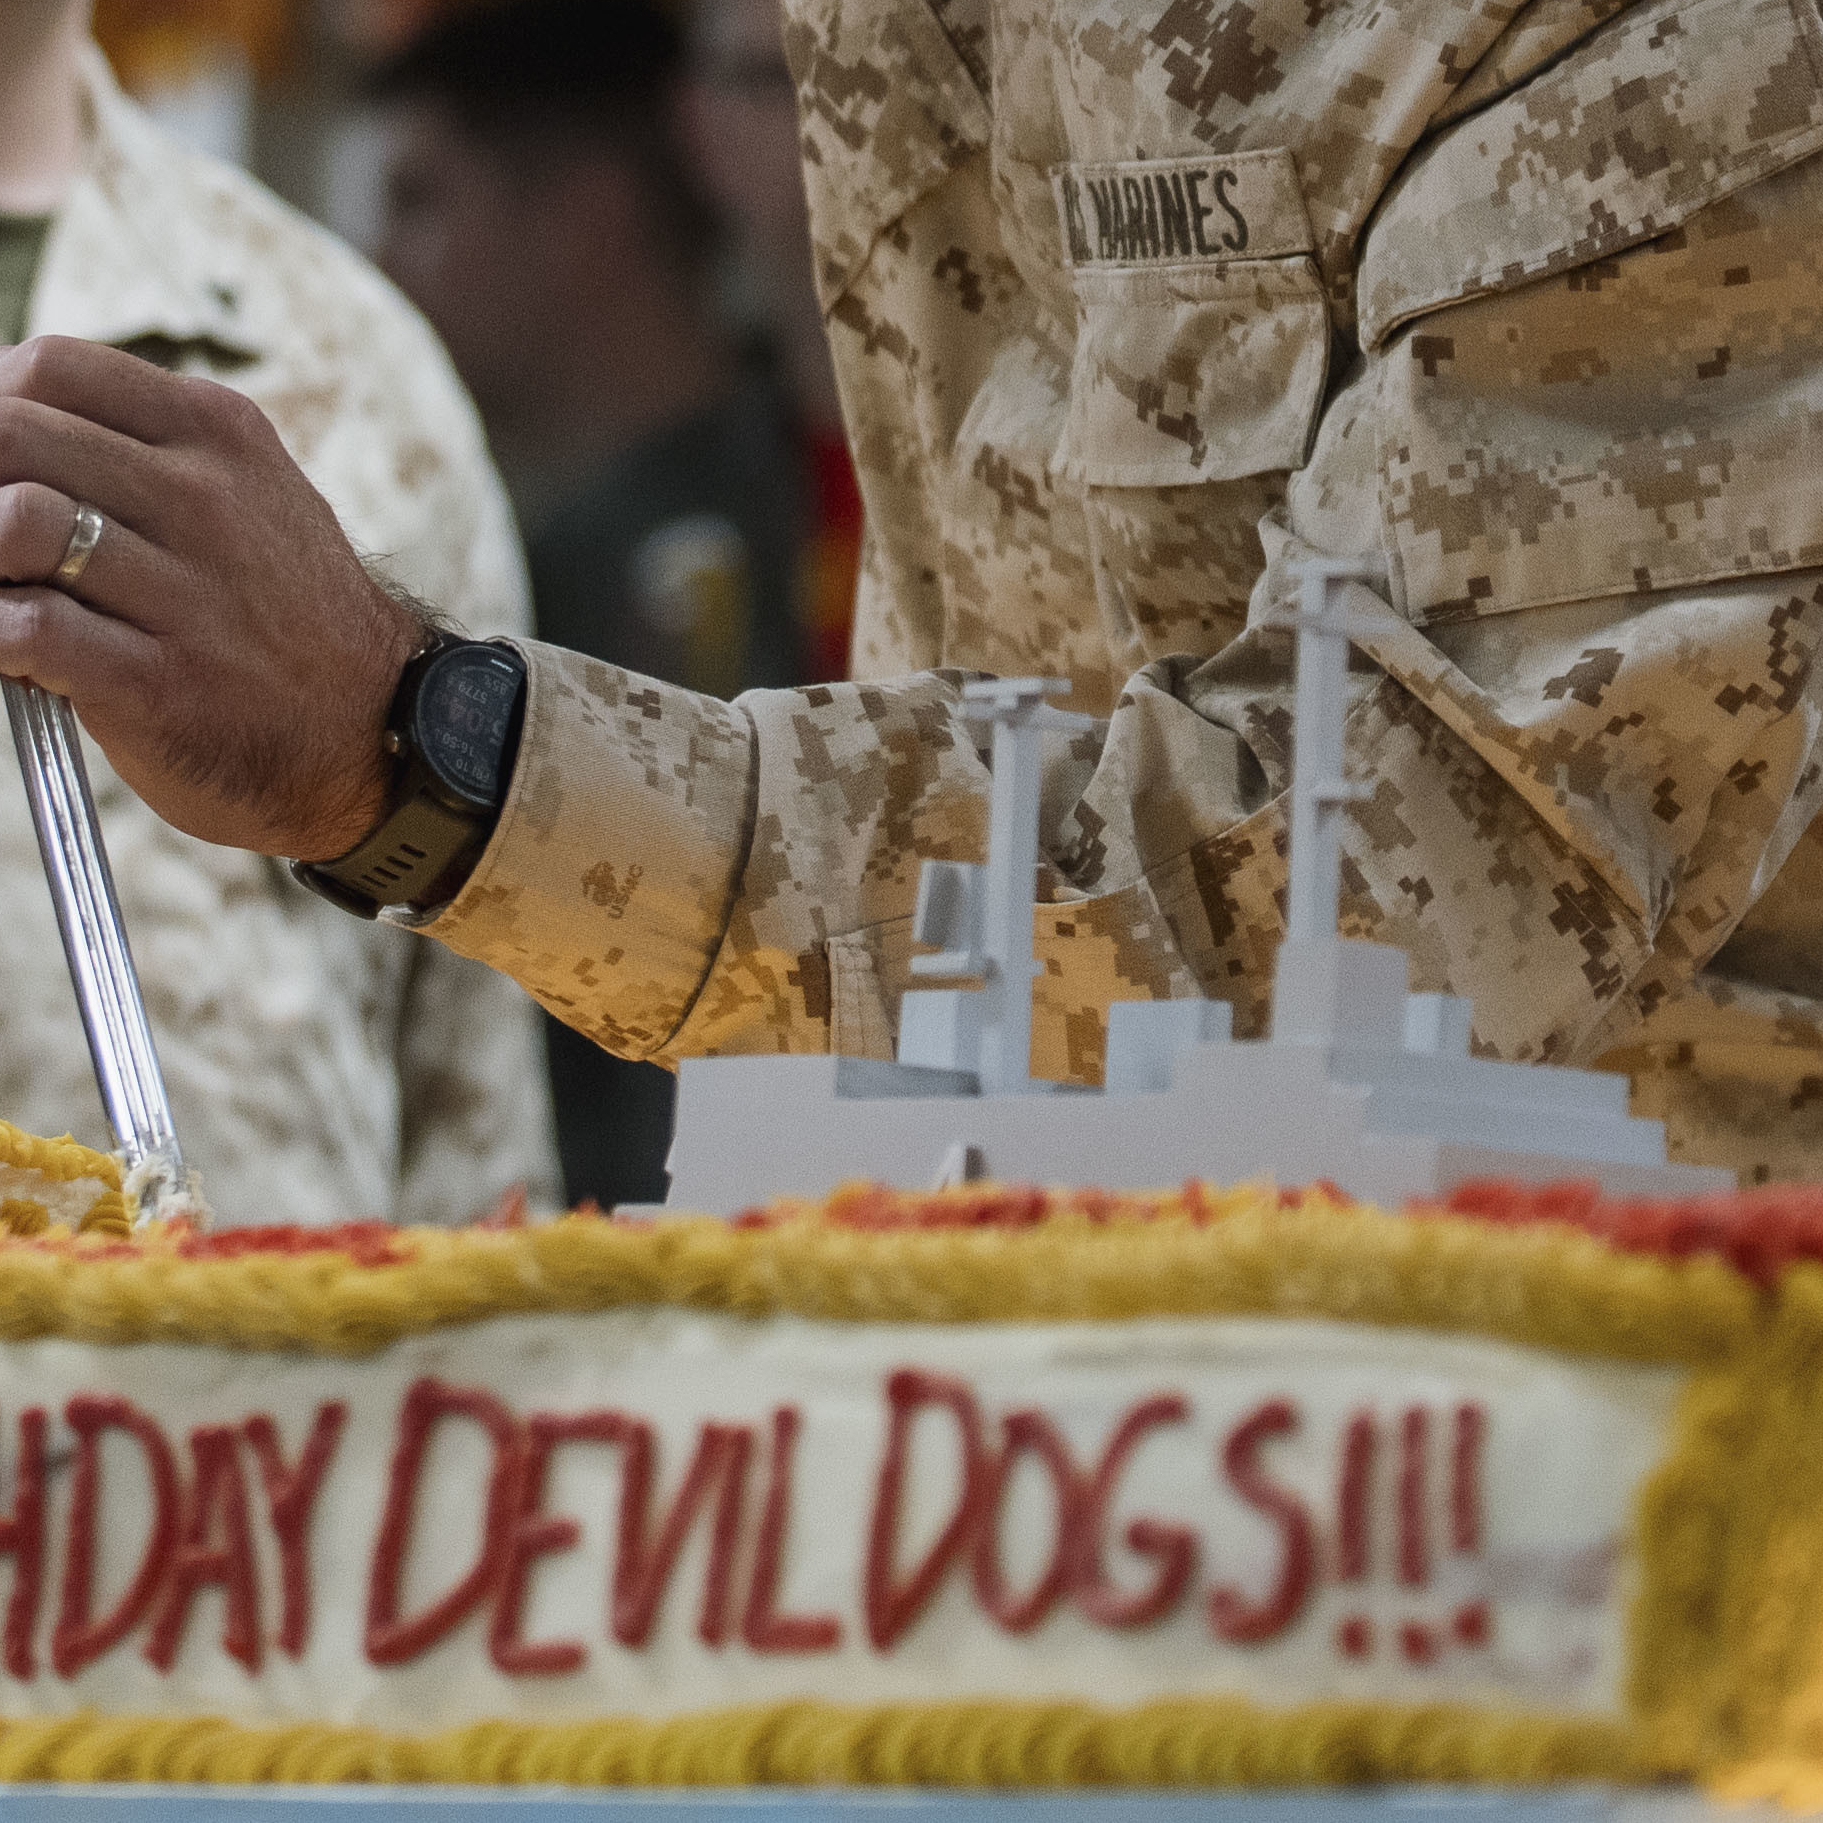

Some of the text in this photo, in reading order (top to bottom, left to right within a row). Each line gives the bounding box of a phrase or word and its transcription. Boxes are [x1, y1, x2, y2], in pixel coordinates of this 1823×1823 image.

[1086, 169, 1249, 261] MARINES
[365, 1377, 843, 1677] DEVIL
[865, 1369, 1490, 1665] DOGS!!!
